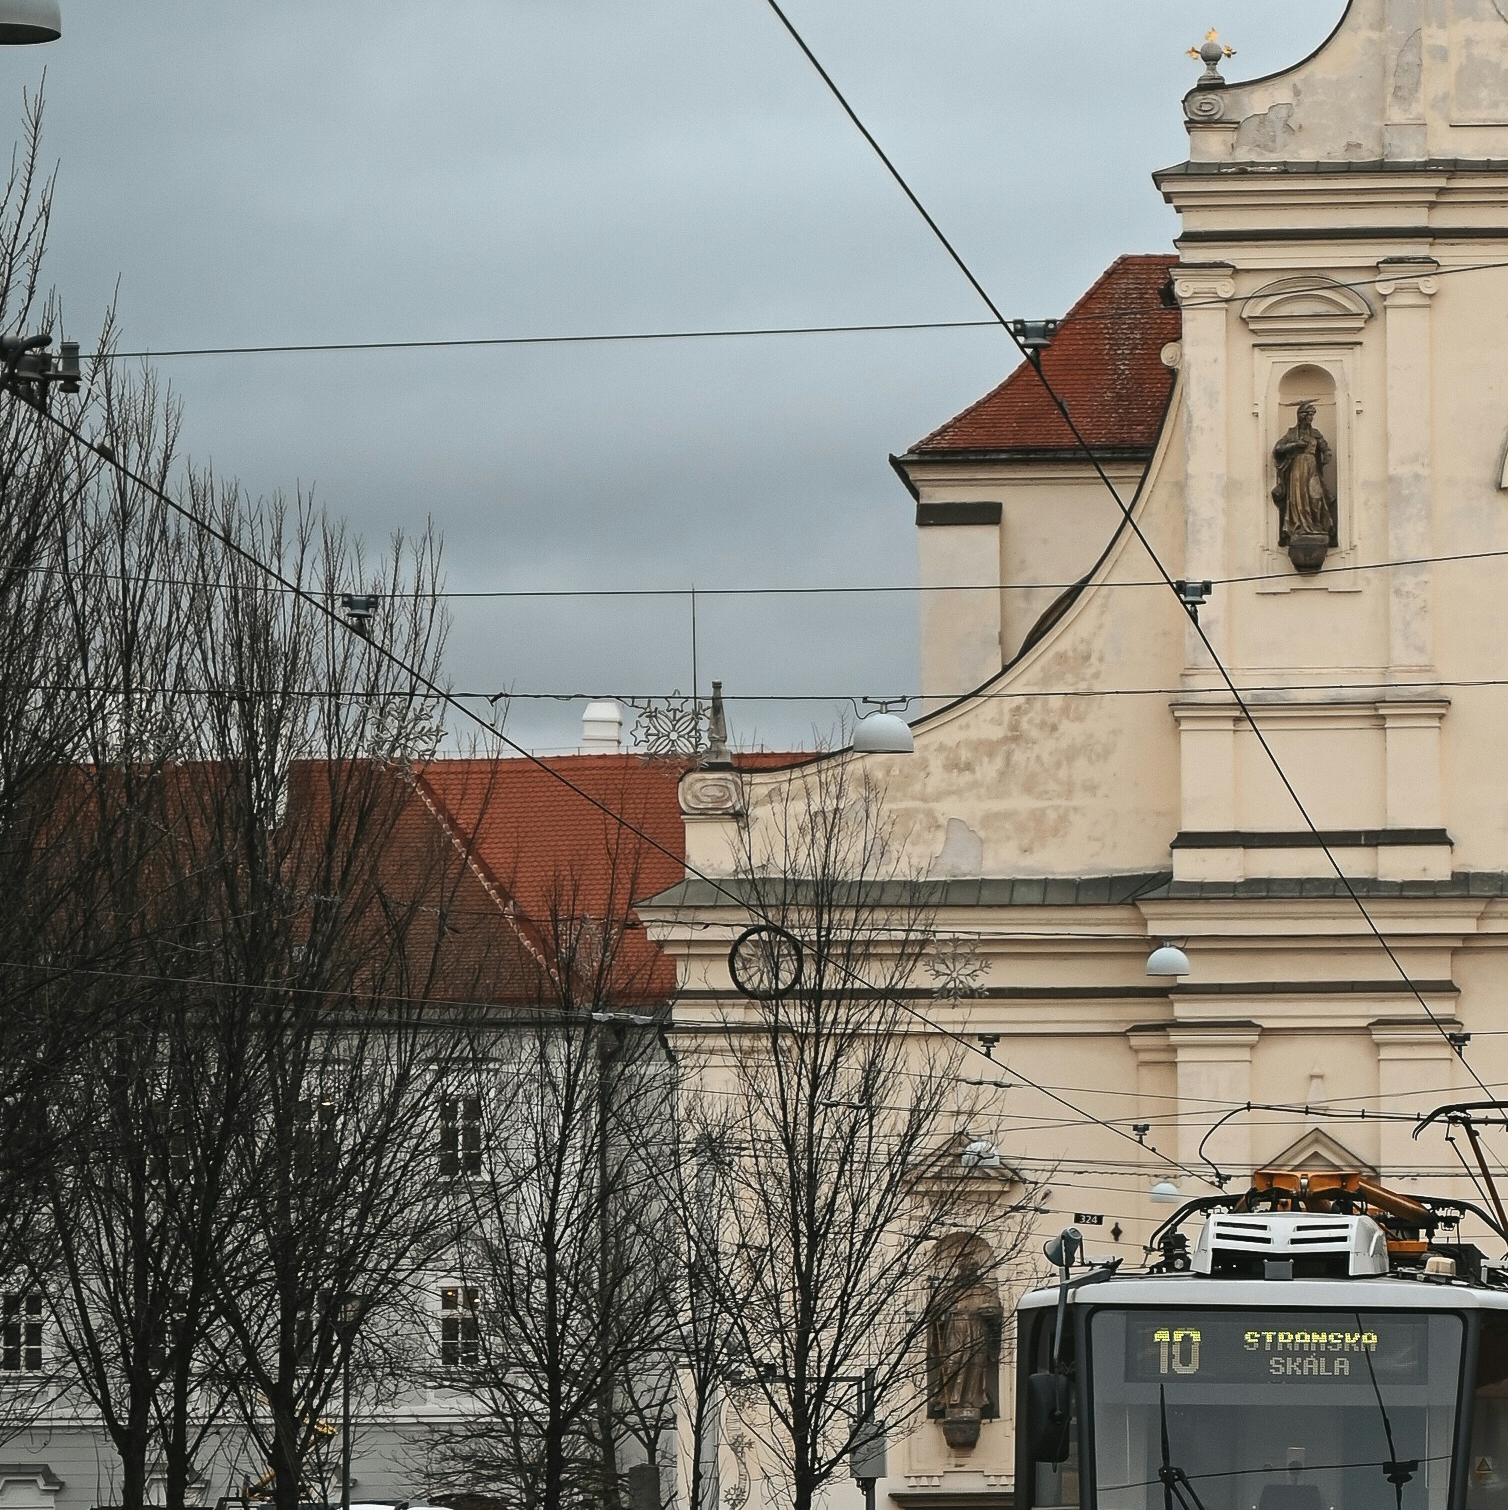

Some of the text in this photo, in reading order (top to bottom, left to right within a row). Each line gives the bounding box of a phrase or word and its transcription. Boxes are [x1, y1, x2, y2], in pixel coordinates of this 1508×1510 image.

[1079, 1214, 1098, 1224] 324
[1154, 1327, 1201, 1374] 10
[1269, 1353, 1350, 1376] SKÁLA
